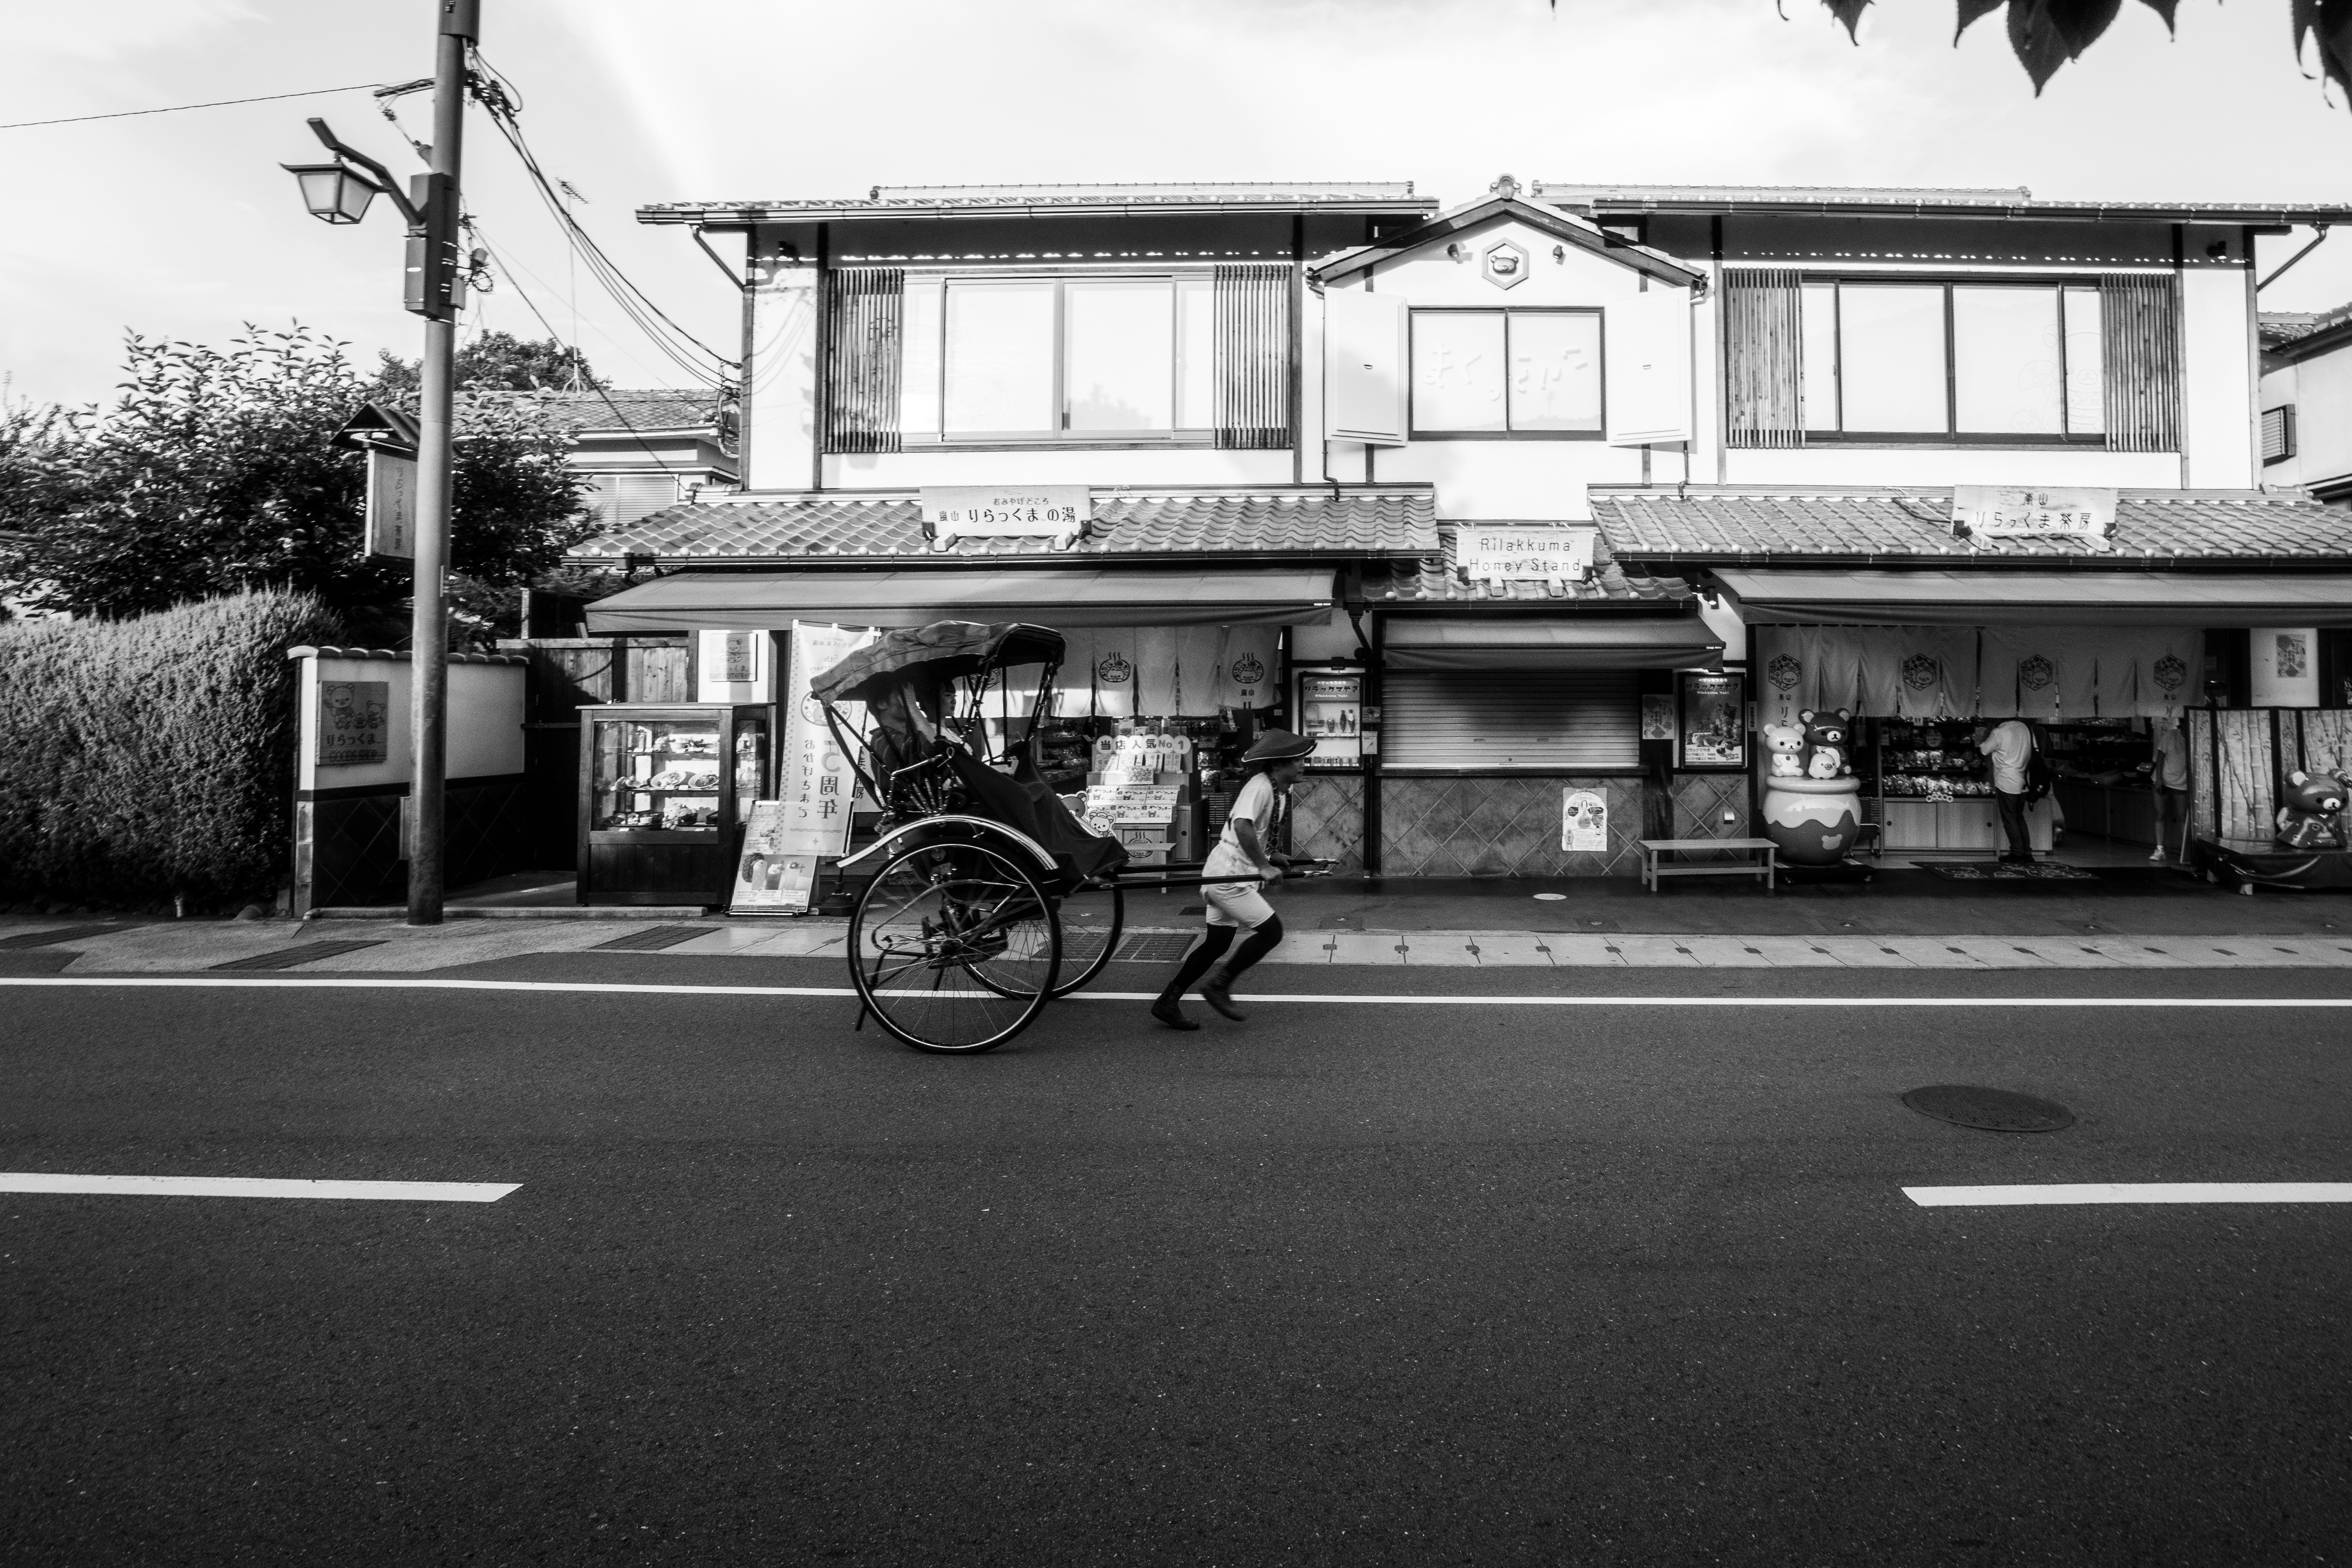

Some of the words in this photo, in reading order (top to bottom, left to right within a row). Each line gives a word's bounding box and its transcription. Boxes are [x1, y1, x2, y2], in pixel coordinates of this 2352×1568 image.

[939, 511, 959, 522] 嵐山
[968, 507, 1076, 523] りらっくまの湯
[1976, 511, 2092, 530] りらっくま茶房
[1481, 538, 1570, 551] Rilakkuma
[1470, 558, 1522, 572] Honey
[1532, 558, 1580, 571] Stand
